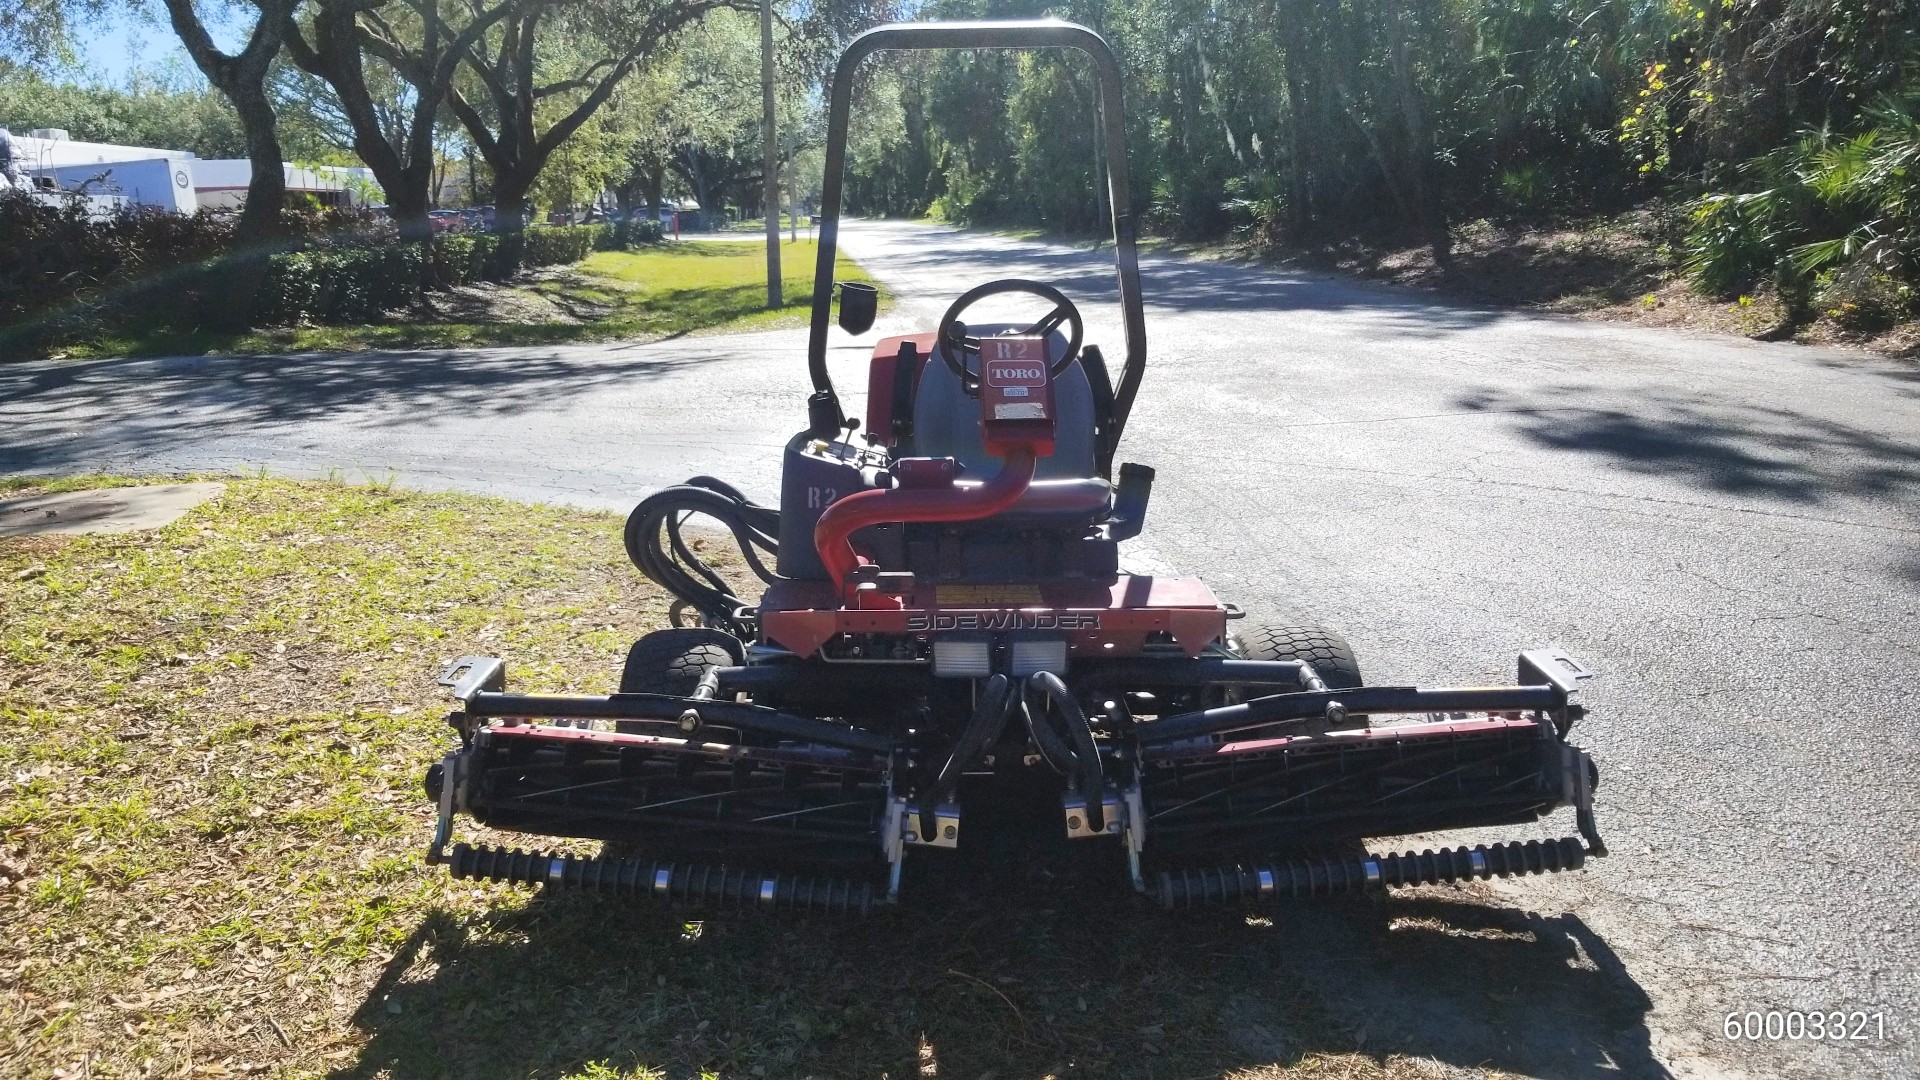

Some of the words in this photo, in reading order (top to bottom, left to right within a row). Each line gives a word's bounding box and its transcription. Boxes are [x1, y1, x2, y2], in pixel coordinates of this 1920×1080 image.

[991, 368, 1041, 379] TORO
[808, 486, 837, 509] R2
[907, 613, 1101, 632] SIDEWINDER
